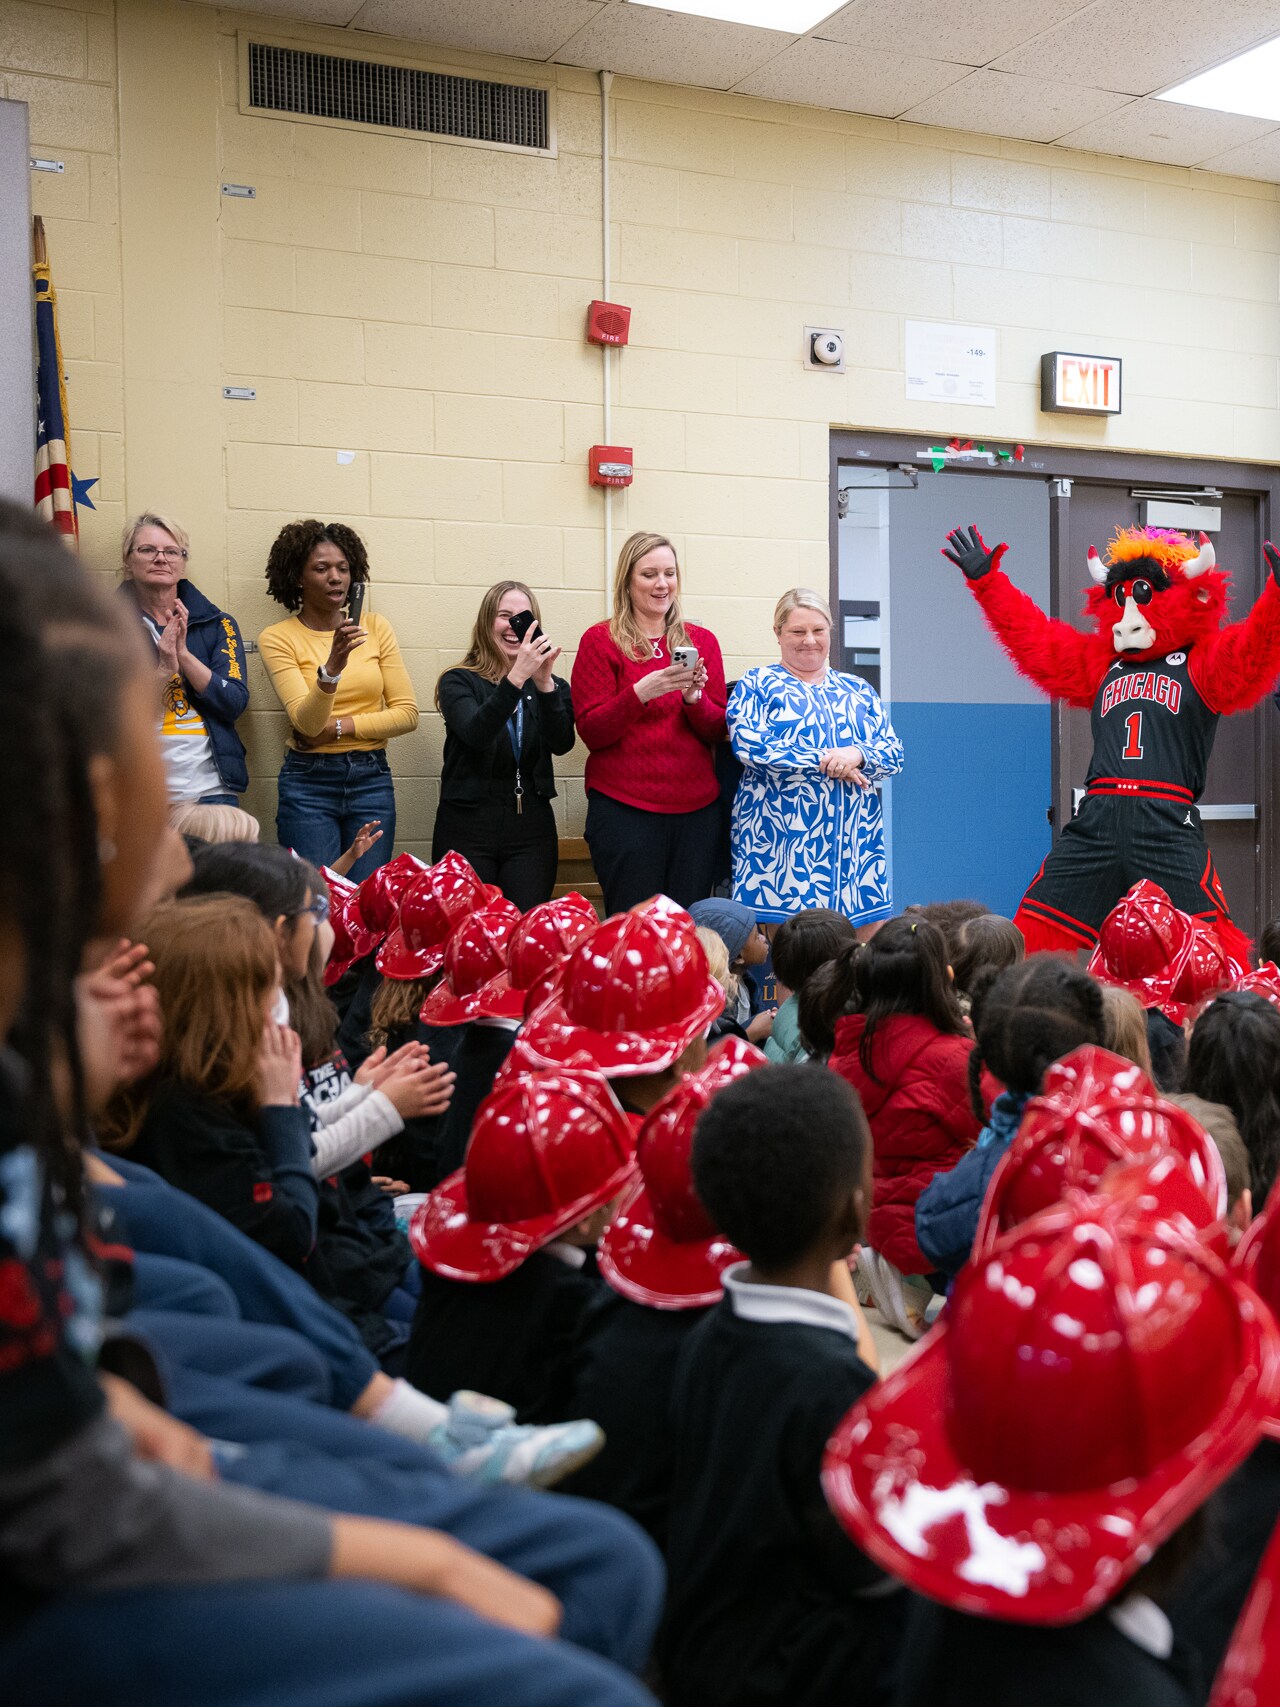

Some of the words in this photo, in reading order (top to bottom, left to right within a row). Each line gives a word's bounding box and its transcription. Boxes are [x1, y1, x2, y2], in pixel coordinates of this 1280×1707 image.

[601, 333, 620, 342] FIRE
[1062, 360, 1113, 406] EXIT
[1101, 672, 1183, 717] CHICAGO
[1122, 711, 1144, 759] 1
